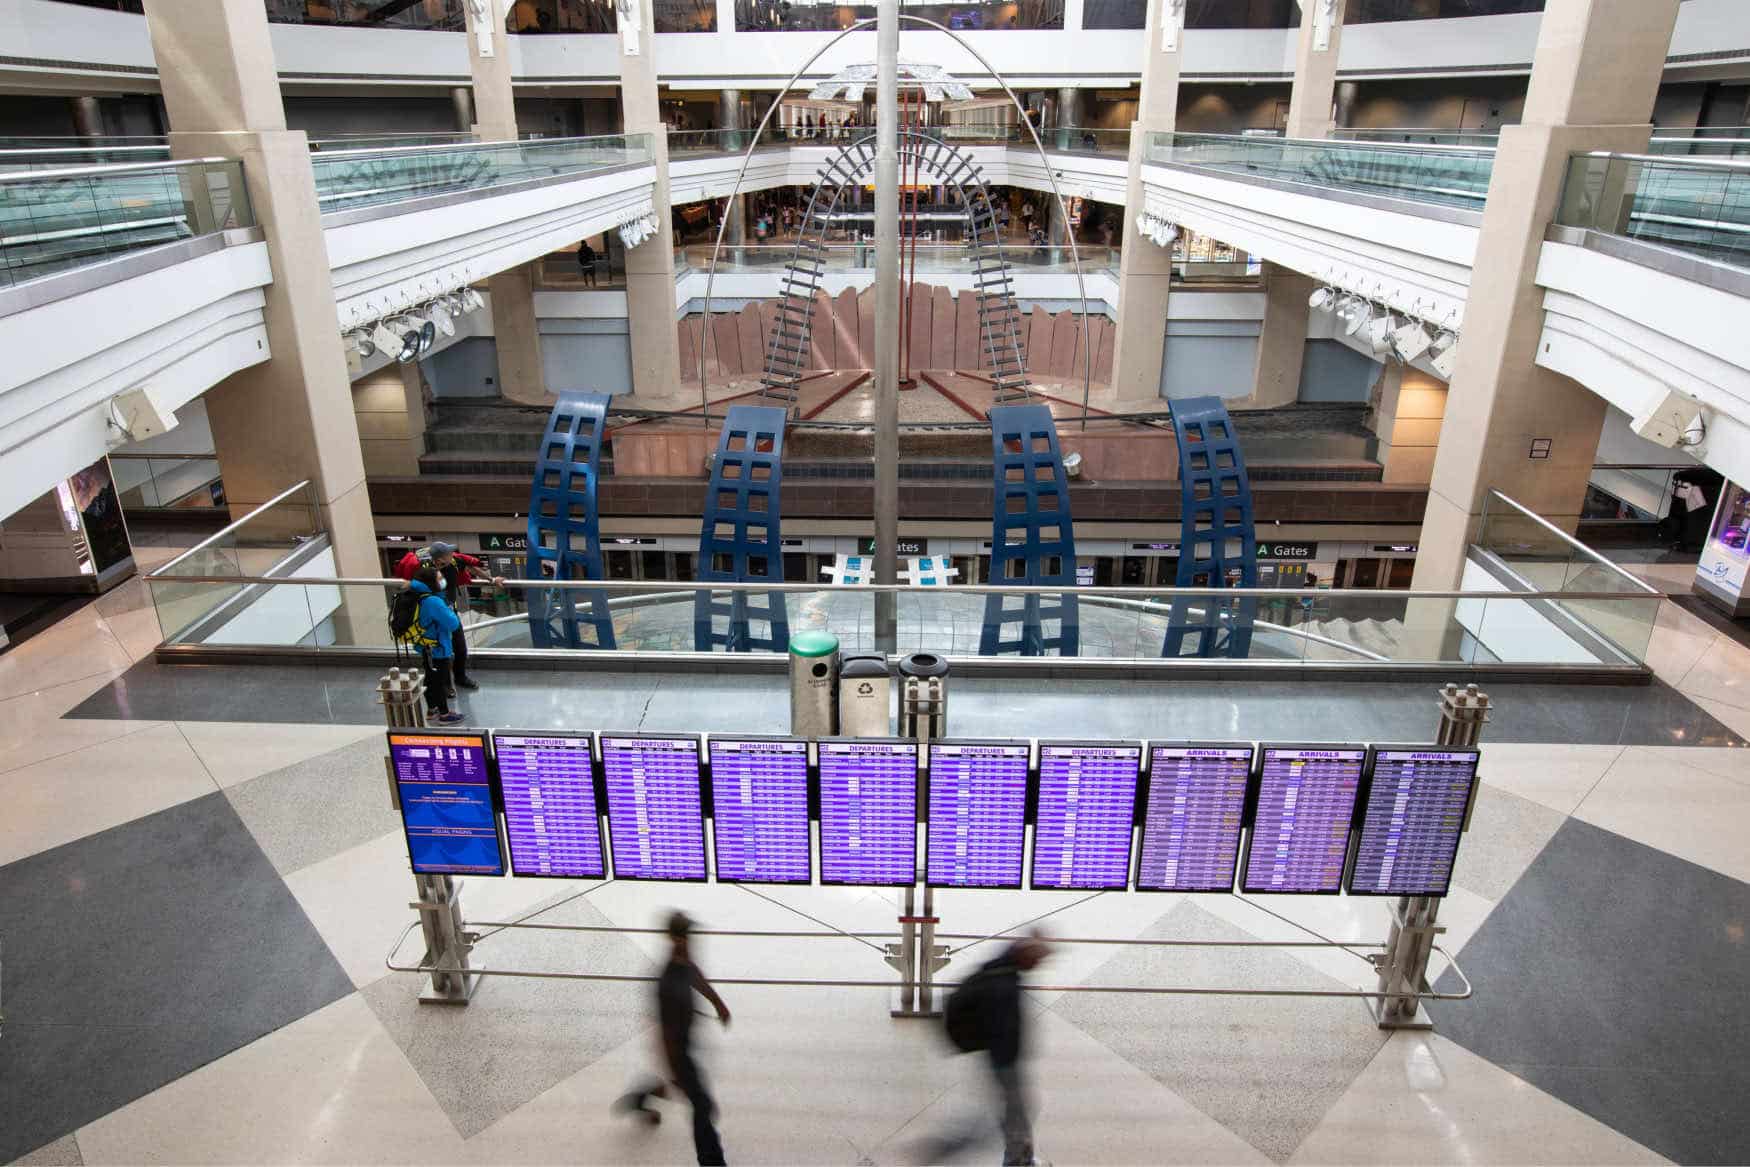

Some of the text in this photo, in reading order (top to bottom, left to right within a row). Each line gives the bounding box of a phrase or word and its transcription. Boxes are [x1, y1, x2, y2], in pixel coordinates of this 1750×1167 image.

[490, 536, 528, 548] A Gat
[896, 543, 919, 552] ates
[1257, 544, 1308, 556] A Gates
[524, 738, 566, 746] DEPARTURES
[631, 740, 675, 748] DEPARTURES
[739, 743, 784, 751] DEPARTURES
[1071, 748, 1116, 756] DEPARTURES
[1186, 749, 1227, 757] ARRIVALS
